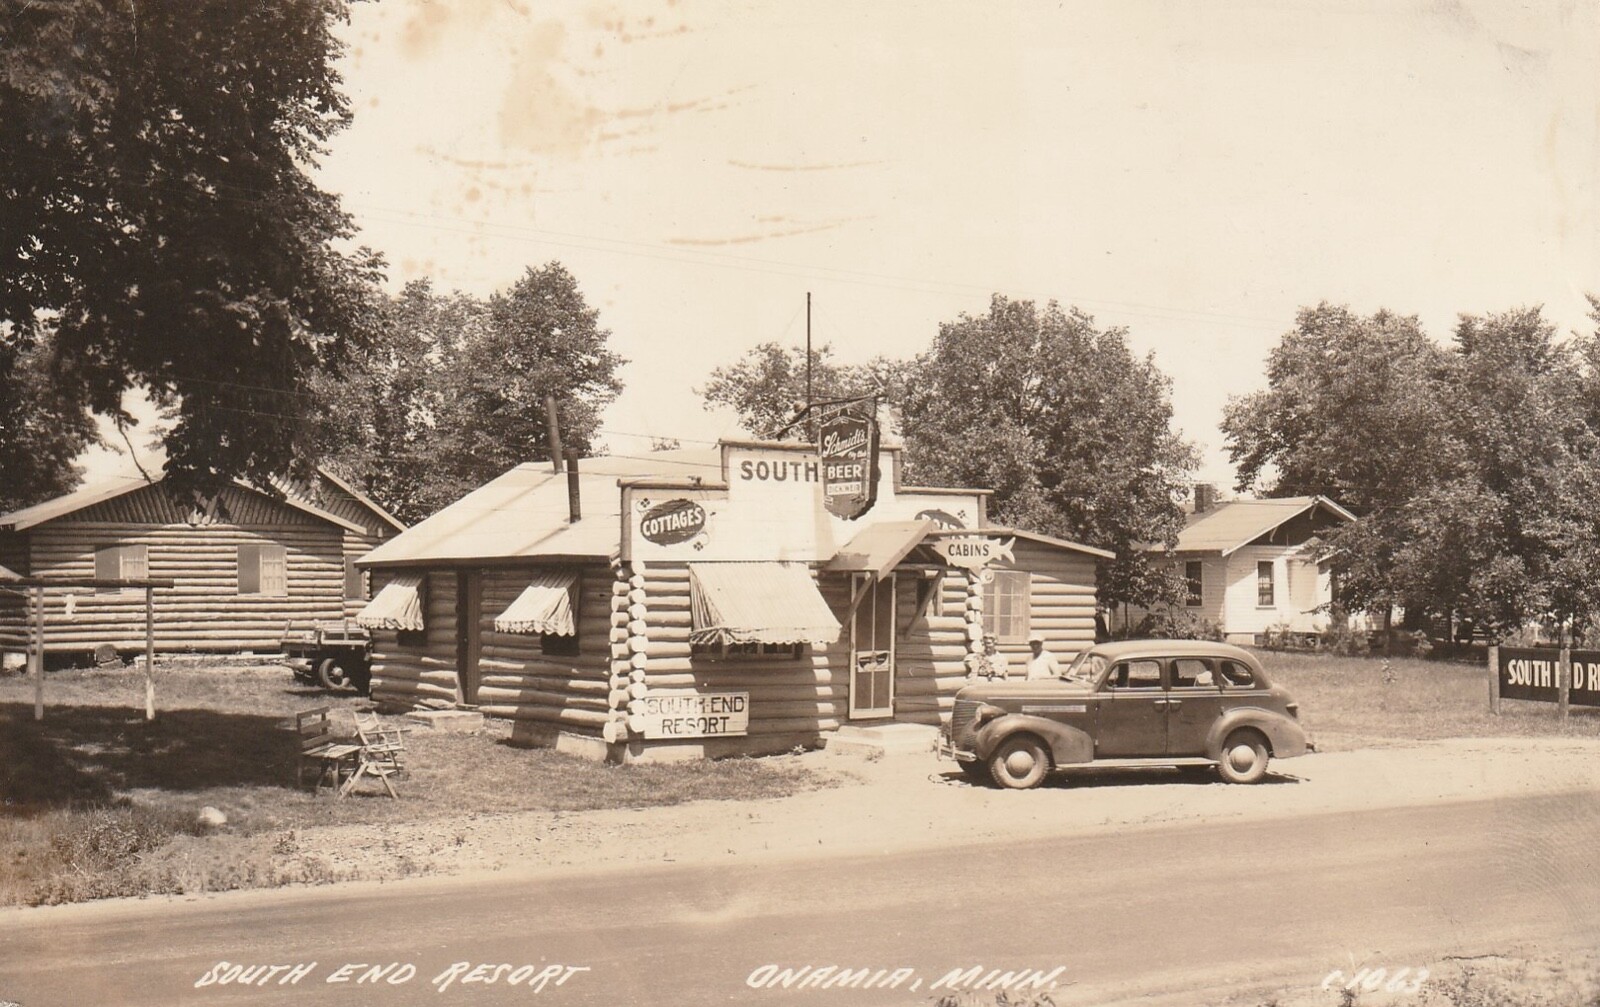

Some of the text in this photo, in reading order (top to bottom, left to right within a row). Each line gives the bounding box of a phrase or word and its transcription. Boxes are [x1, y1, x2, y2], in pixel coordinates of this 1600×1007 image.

[740, 460, 818, 482] SOUTH
[828, 464, 862, 480] BEER
[642, 507, 702, 537] COTTAGES
[948, 543, 990, 556] CABINS
[1508, 659, 1551, 687] SOUTH
[661, 716, 730, 734] RESORT
